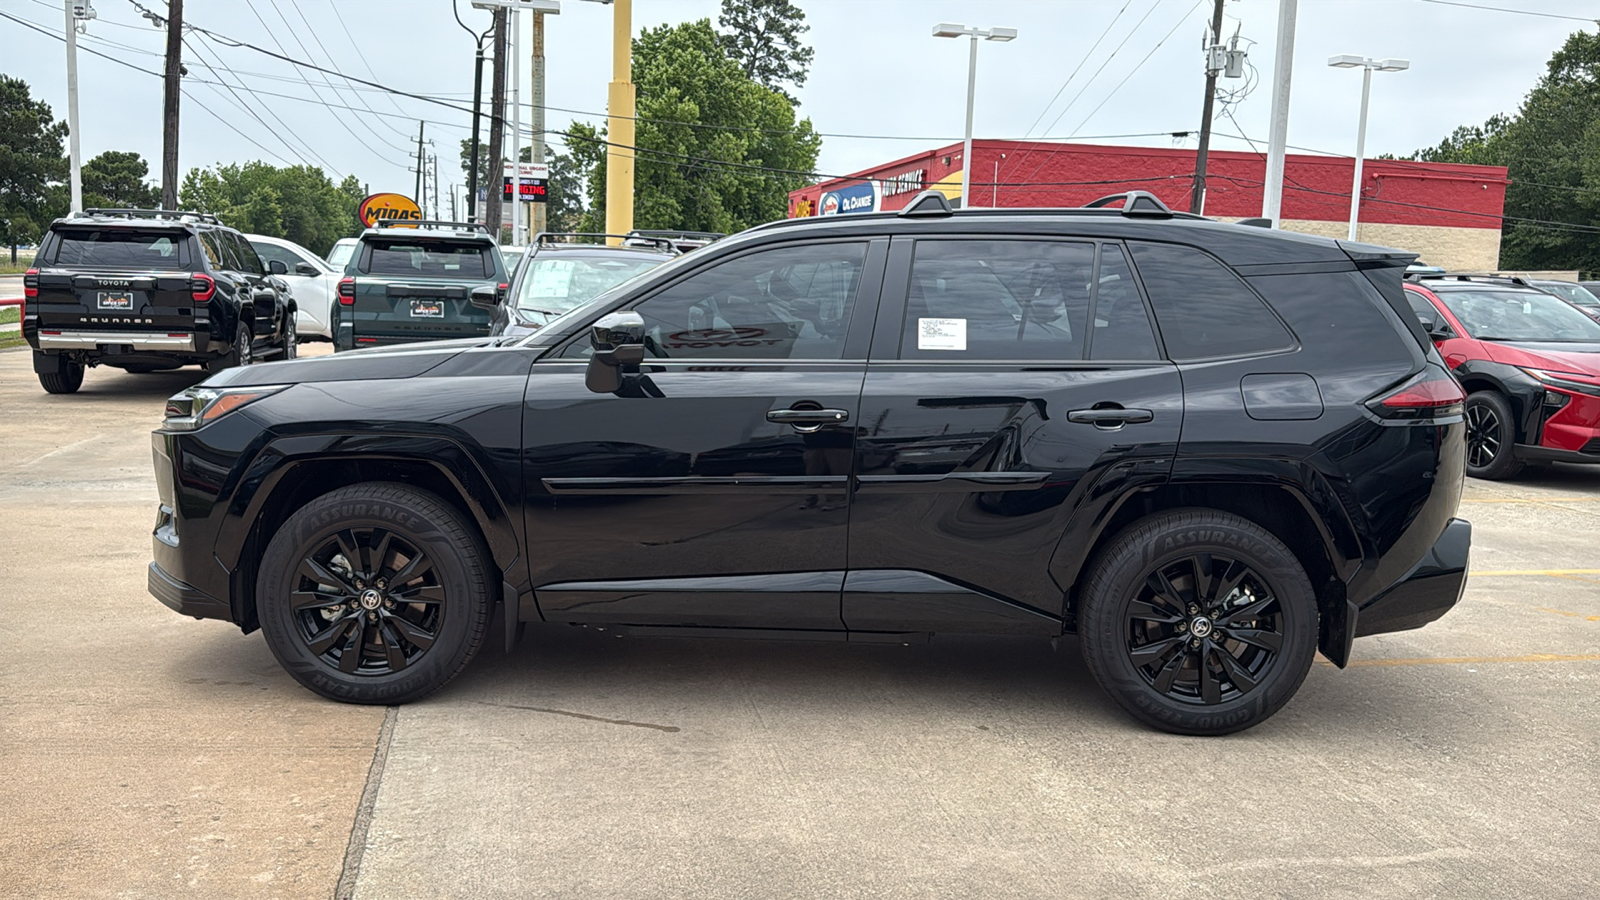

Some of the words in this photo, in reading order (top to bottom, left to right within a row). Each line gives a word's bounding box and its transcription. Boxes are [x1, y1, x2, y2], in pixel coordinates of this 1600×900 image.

[897, 169, 923, 194] SERVICE
[309, 503, 420, 531] ASSURANCE
[1164, 529, 1275, 563] ASSURANCE
